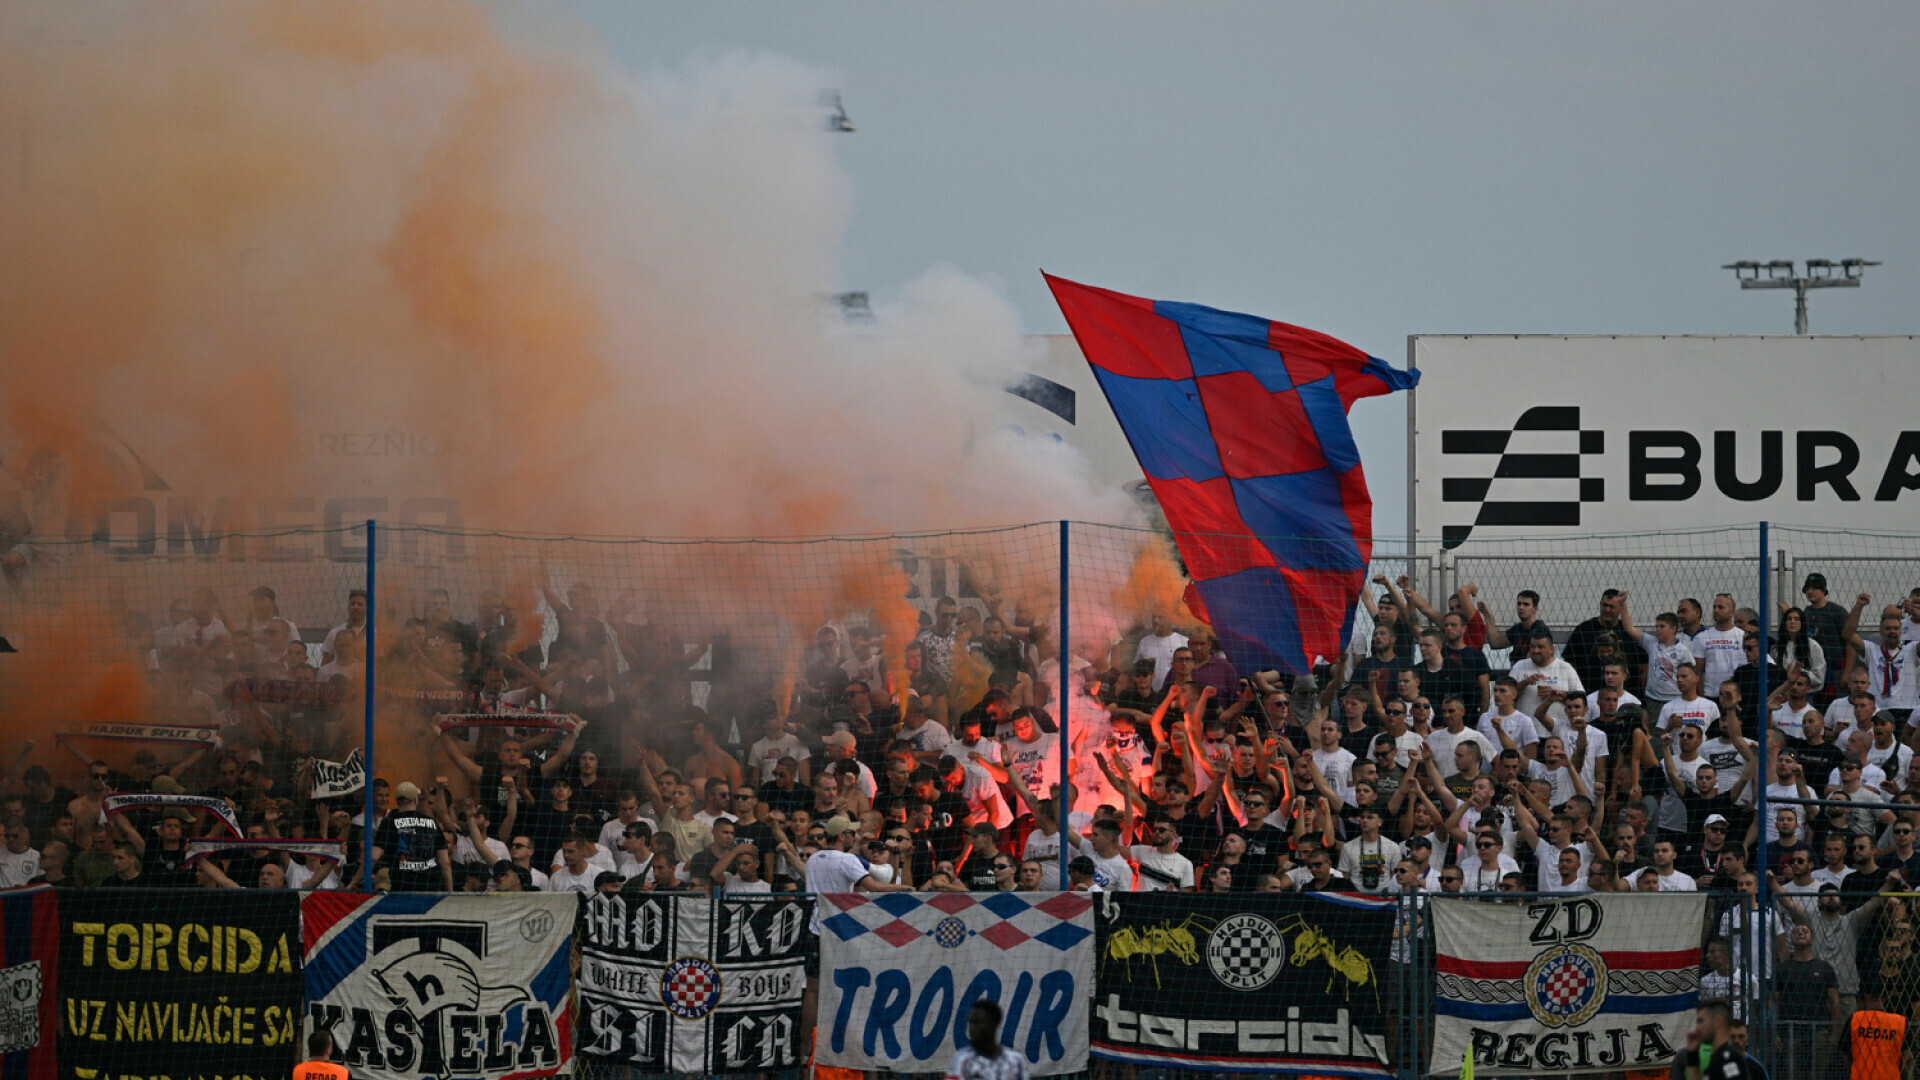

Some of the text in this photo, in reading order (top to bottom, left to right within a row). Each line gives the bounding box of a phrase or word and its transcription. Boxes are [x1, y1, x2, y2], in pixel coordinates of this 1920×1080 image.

[88, 723, 192, 738] HAJDUK SPLIT
[1216, 918, 1276, 942] HAJDUK
[1527, 899, 1603, 946] ZD
[73, 921, 293, 975] TORCIDA
[667, 958, 717, 979] HAJDUK
[1541, 955, 1592, 977] HAJDUK
[1221, 968, 1270, 987] SPLIT
[670, 1002, 709, 1018] SPLIT
[1544, 999, 1583, 1015] SPLIT
[68, 996, 294, 1047] UZ NAVIJAČE SA
[1857, 1026, 1897, 1041] REDAR
[1463, 1021, 1677, 1071] REGIJA
